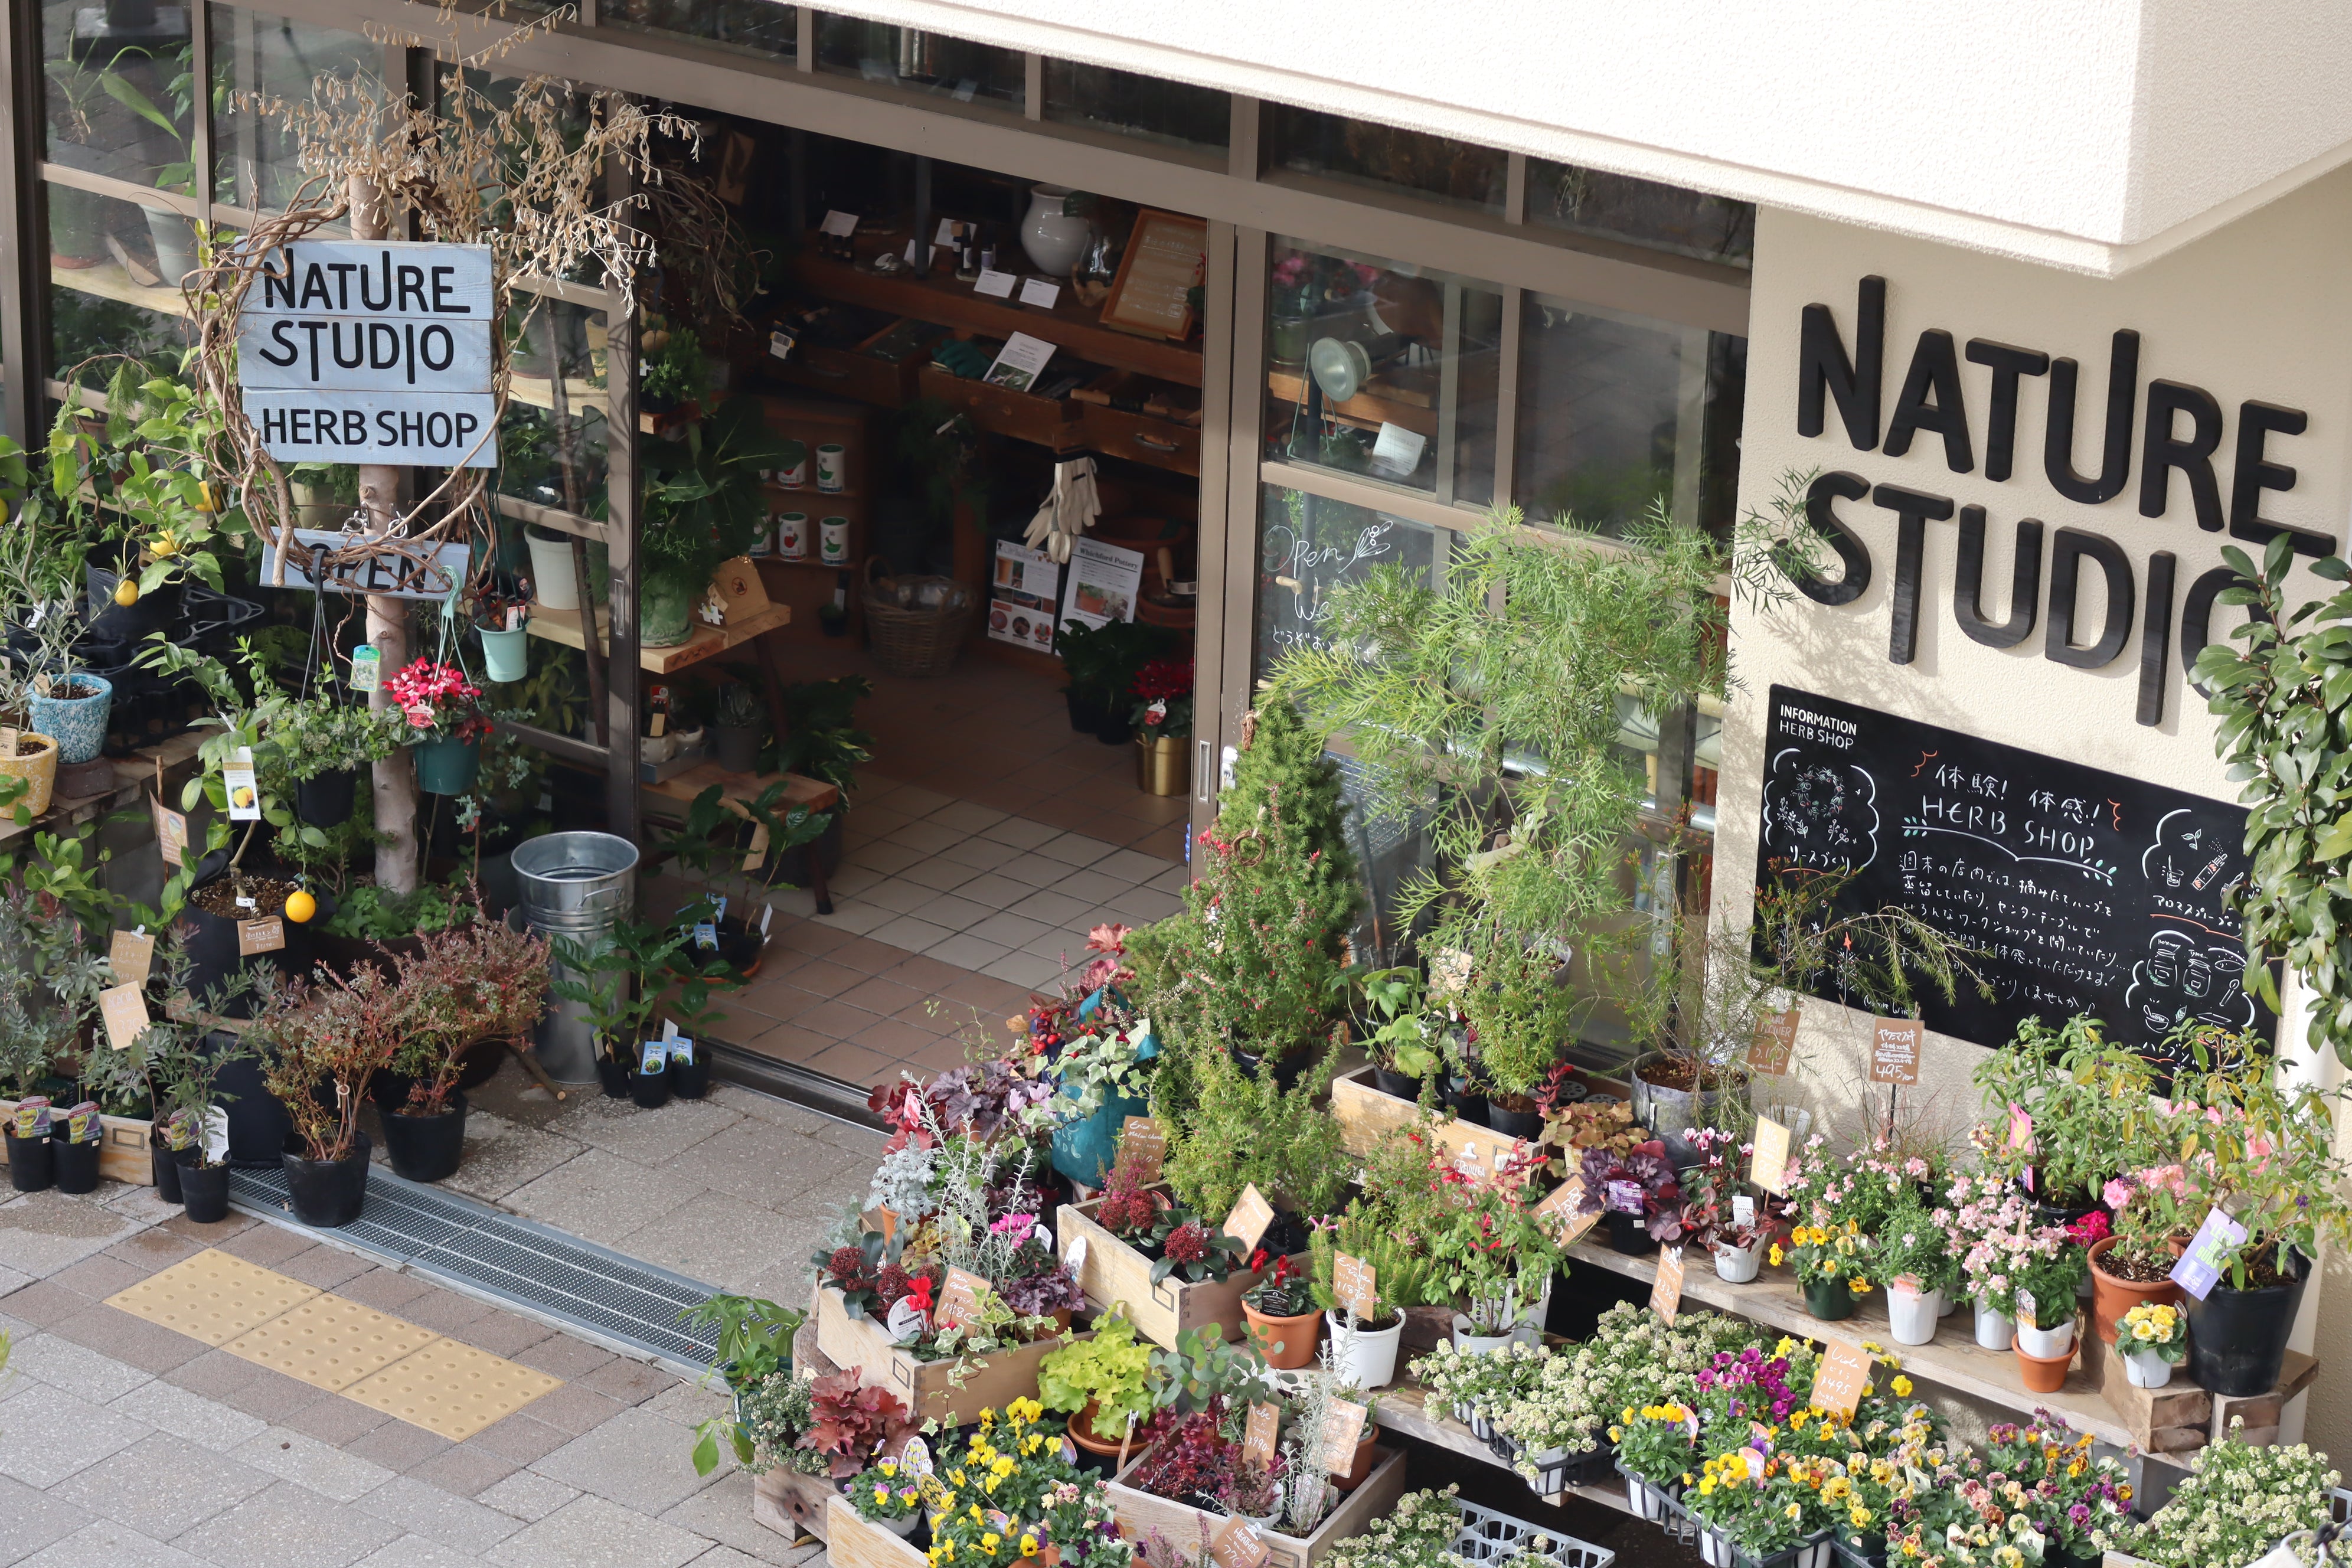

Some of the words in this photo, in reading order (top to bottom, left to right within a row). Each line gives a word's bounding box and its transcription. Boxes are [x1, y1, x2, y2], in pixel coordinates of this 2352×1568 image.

[263, 248, 471, 313] NATURE
[259, 319, 455, 384] STUDIO
[263, 408, 368, 447] HERB
[375, 410, 478, 448] SHOP
[1797, 274, 2337, 558] NATURE
[1080, 547, 1113, 563] Whichford
[1115, 557, 1139, 570] Pottery
[1770, 470, 2274, 727] STUDIO
[1780, 704, 1857, 736] INFORMATION
[1779, 720, 1814, 740] HERB
[1817, 729, 1854, 750] SHOP
[1922, 794, 2006, 834] HERB
[2024, 820, 2095, 858] SHOP
[107, 991, 136, 1008] ACACIA
[1760, 1022, 1792, 1038] FLOWER
[1769, 1013, 1786, 1025] WAX
[1764, 1123, 1778, 1142] BIG
[1761, 1137, 1782, 1157] BELLY
[1561, 1198, 1579, 1220] RED
[2210, 1223, 2236, 1246] LET'S
[2195, 1245, 2219, 1269] BUDS
[1831, 1346, 1860, 1369] Viola
[1233, 1527, 1260, 1557] HEATHER
